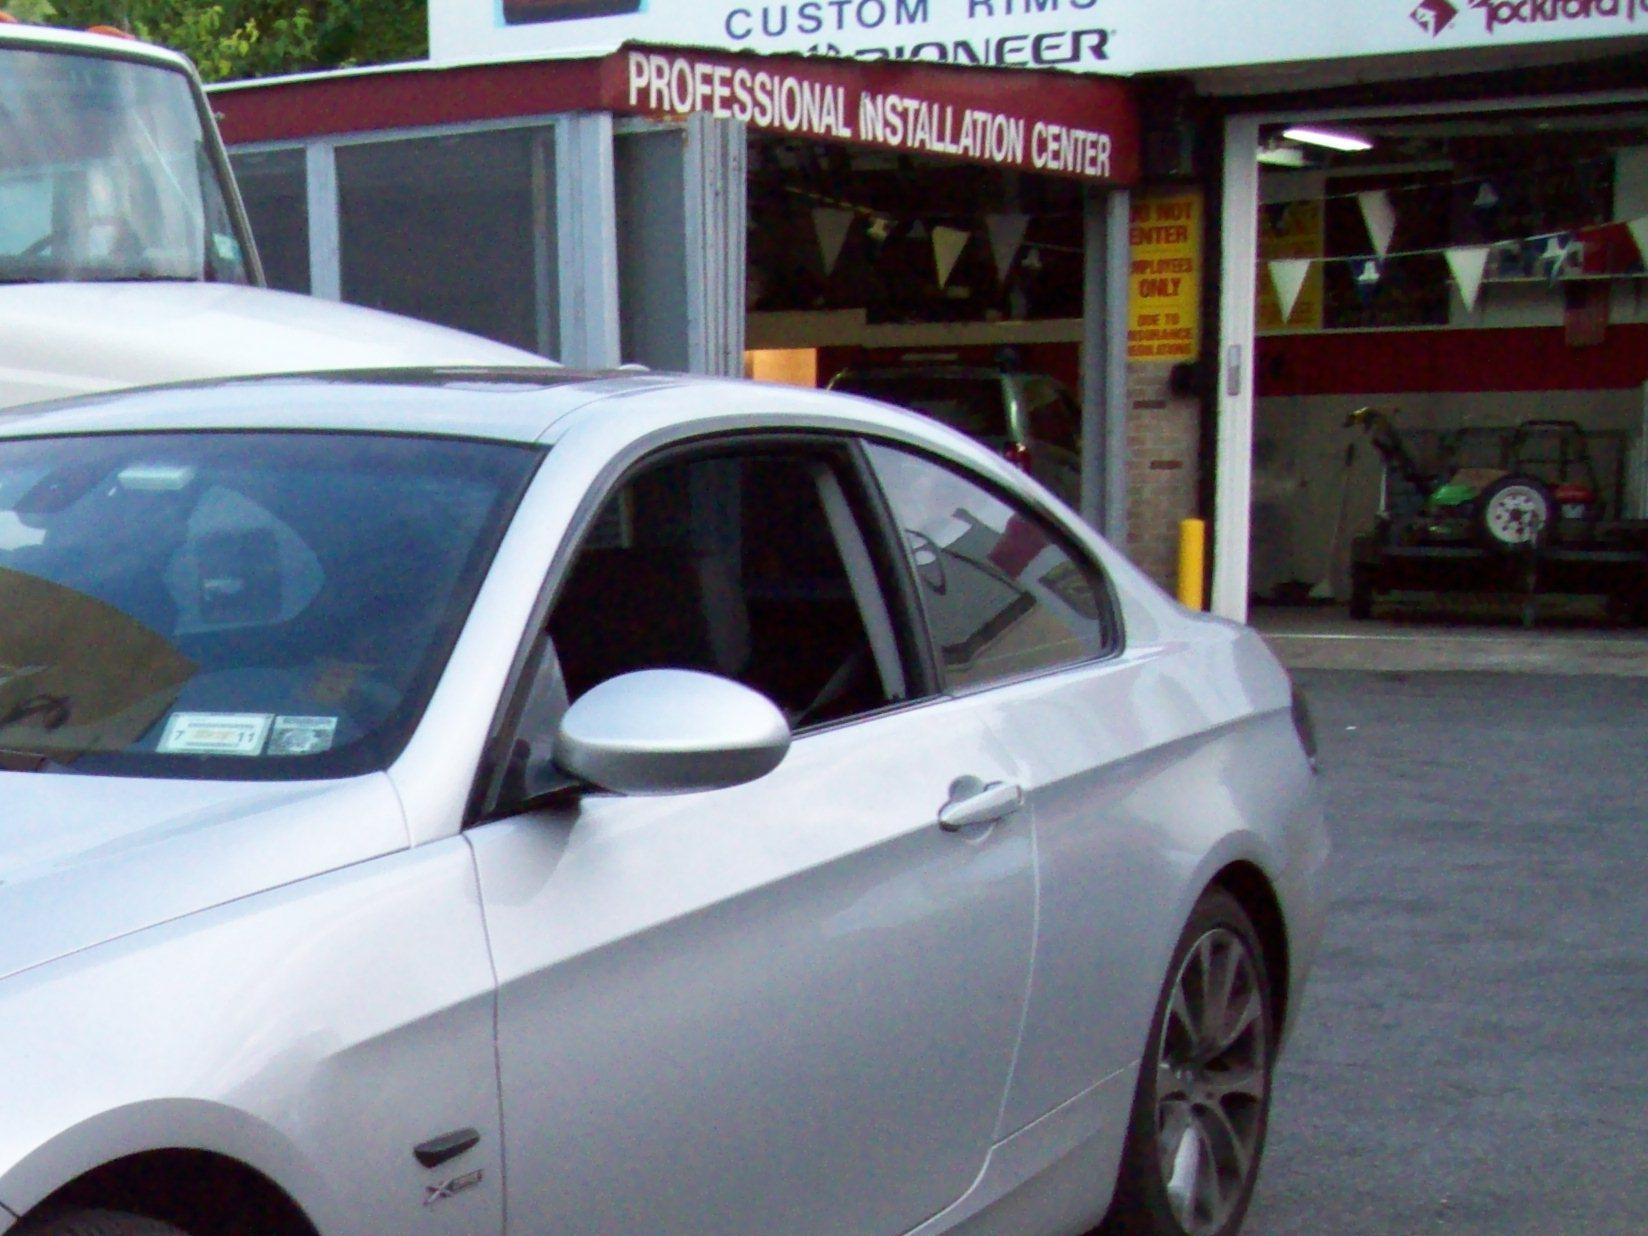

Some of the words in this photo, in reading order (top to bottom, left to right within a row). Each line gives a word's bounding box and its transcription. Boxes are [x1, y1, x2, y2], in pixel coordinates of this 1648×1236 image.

[725, 0, 929, 40] CUSTOM
[968, 0, 1098, 18] RIM
[629, 51, 852, 138] PROFESSIONAL
[858, 90, 1024, 165] INSTALLATION
[1031, 121, 1112, 177] CENTER
[1156, 202, 1193, 221] NOT
[1130, 225, 1188, 245] ENTER
[1131, 258, 1193, 275] MPLOYEES
[1138, 277, 1182, 298] ONLY
